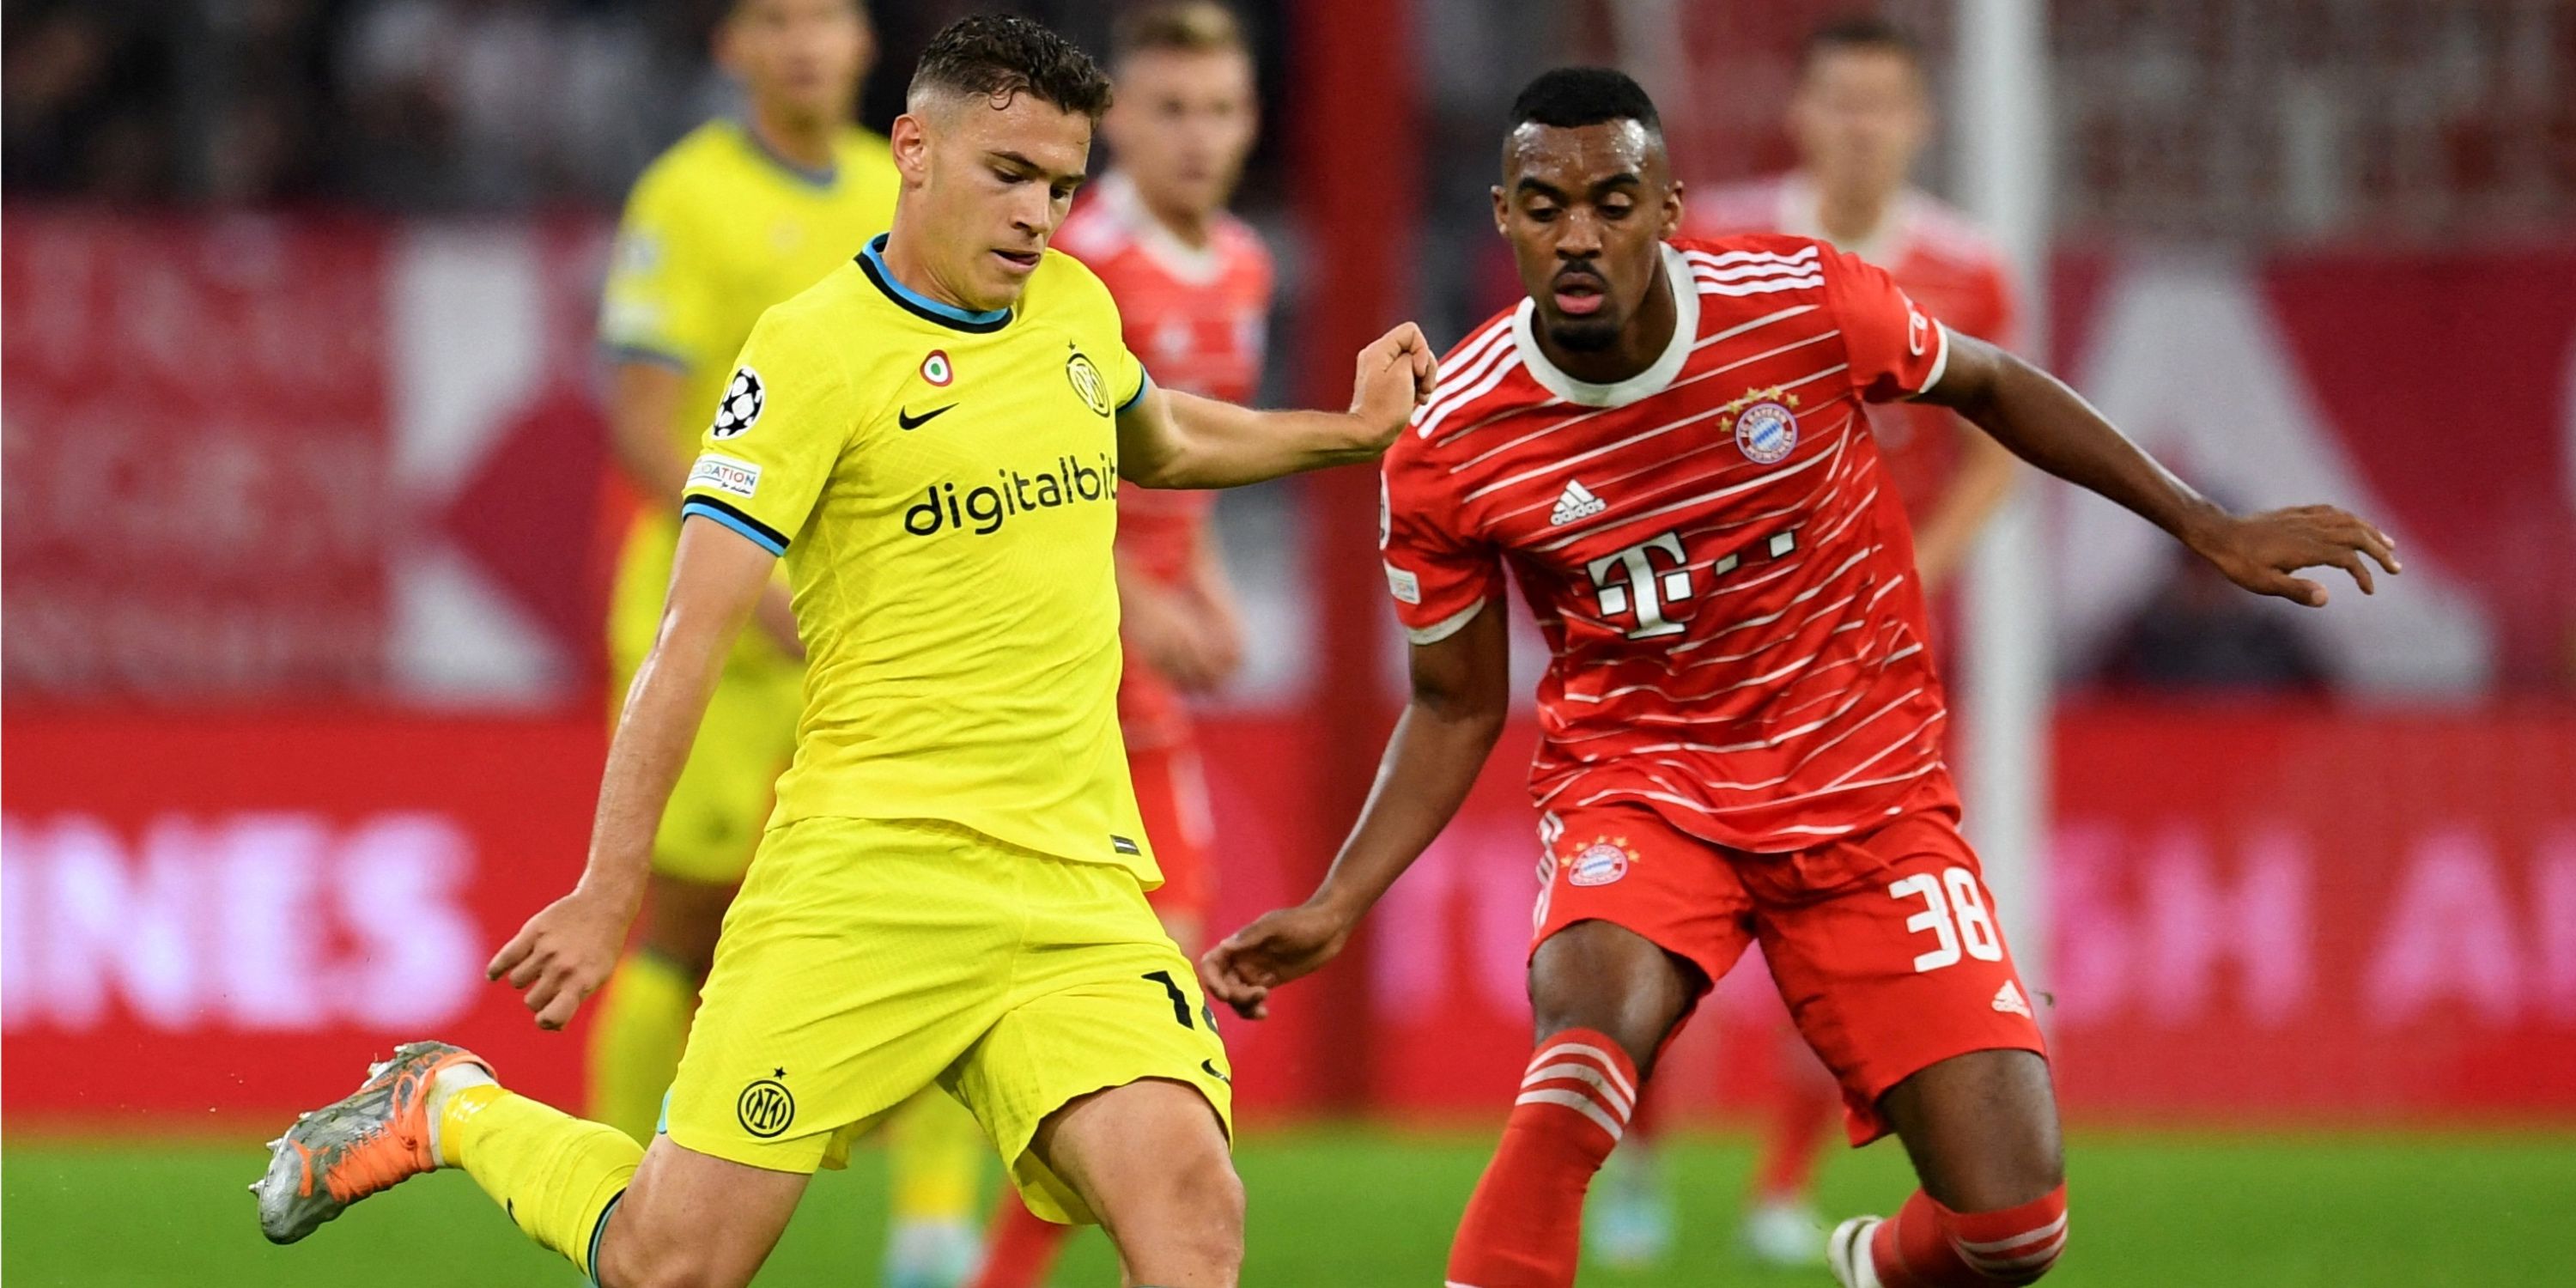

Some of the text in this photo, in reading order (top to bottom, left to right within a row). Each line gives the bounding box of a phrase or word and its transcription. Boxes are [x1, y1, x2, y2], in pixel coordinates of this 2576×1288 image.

[904, 453, 1116, 536] digitalbit
[1888, 866, 2003, 973] 38
[1140, 969, 1219, 1033] 1
